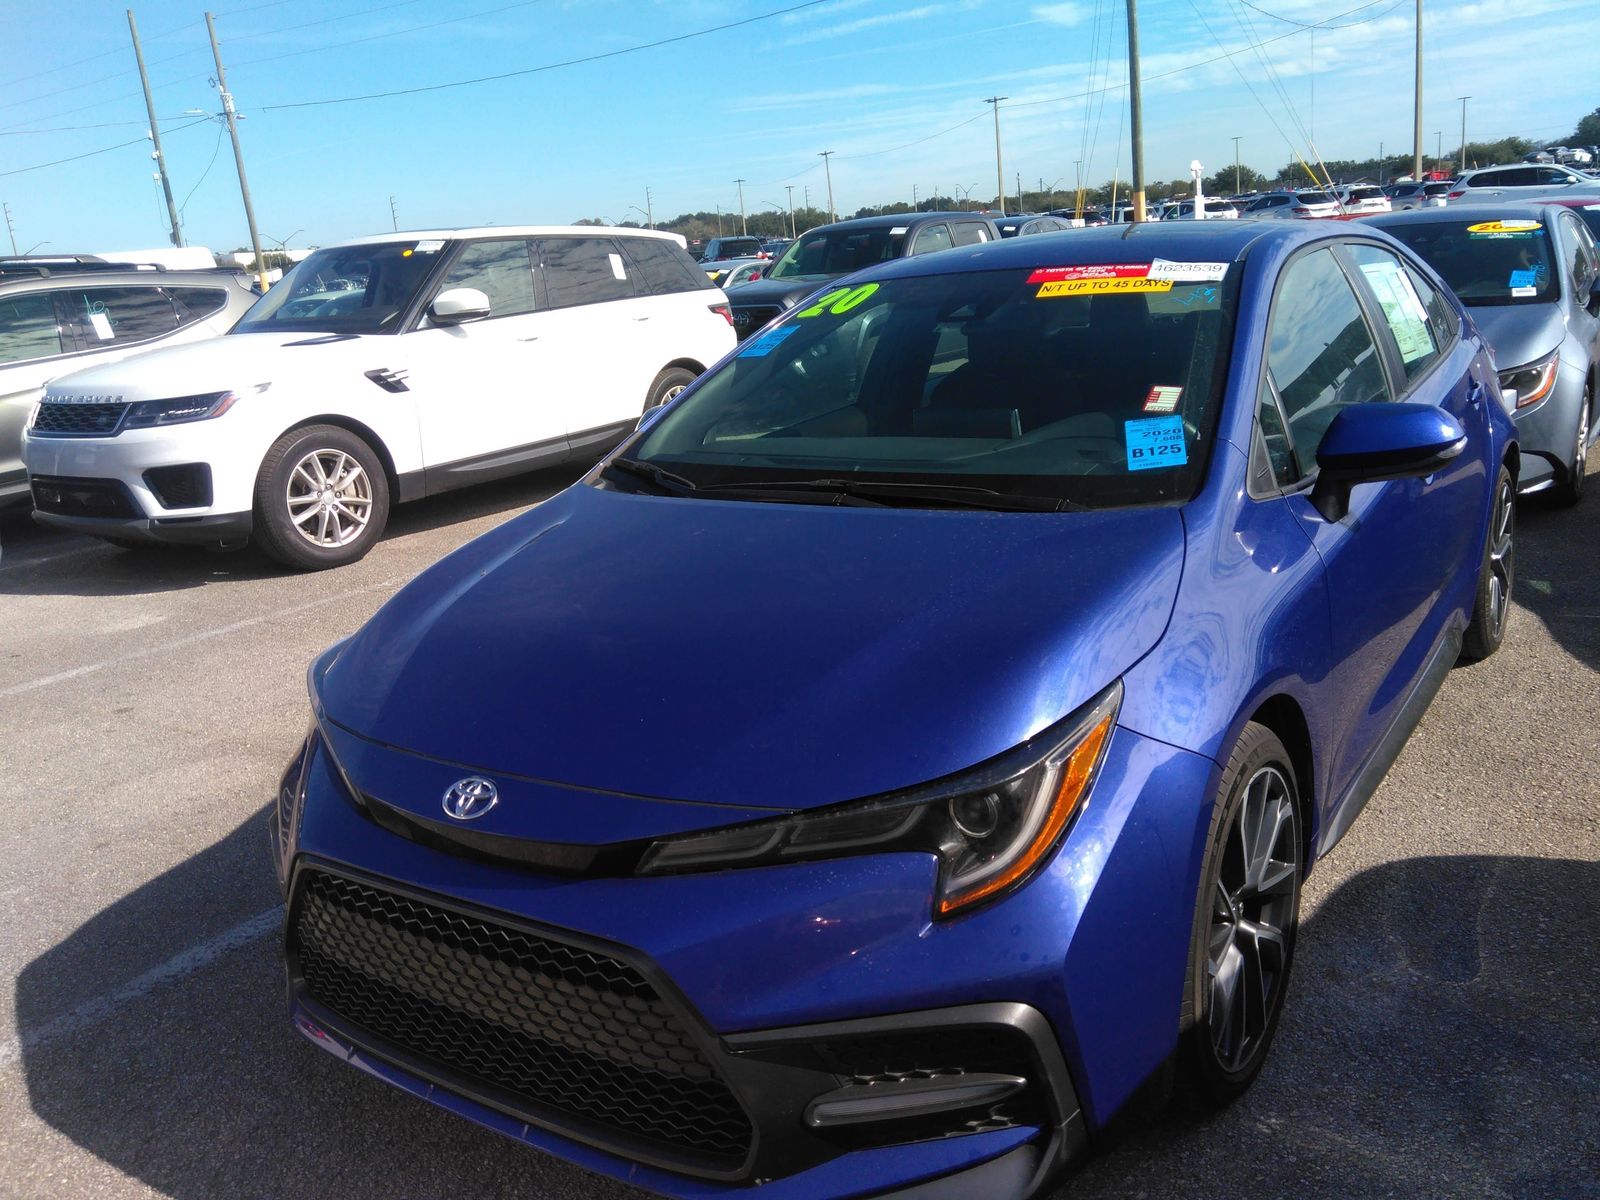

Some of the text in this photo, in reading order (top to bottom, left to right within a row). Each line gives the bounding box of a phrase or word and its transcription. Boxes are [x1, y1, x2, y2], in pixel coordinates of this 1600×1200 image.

[1154, 264, 1223, 272] 4623539
[1041, 278, 1171, 293] N/T UP TO 45 DAYS
[796, 283, 880, 319] 20
[1142, 428, 1181, 437] 2020
[1132, 443, 1181, 458] B125
